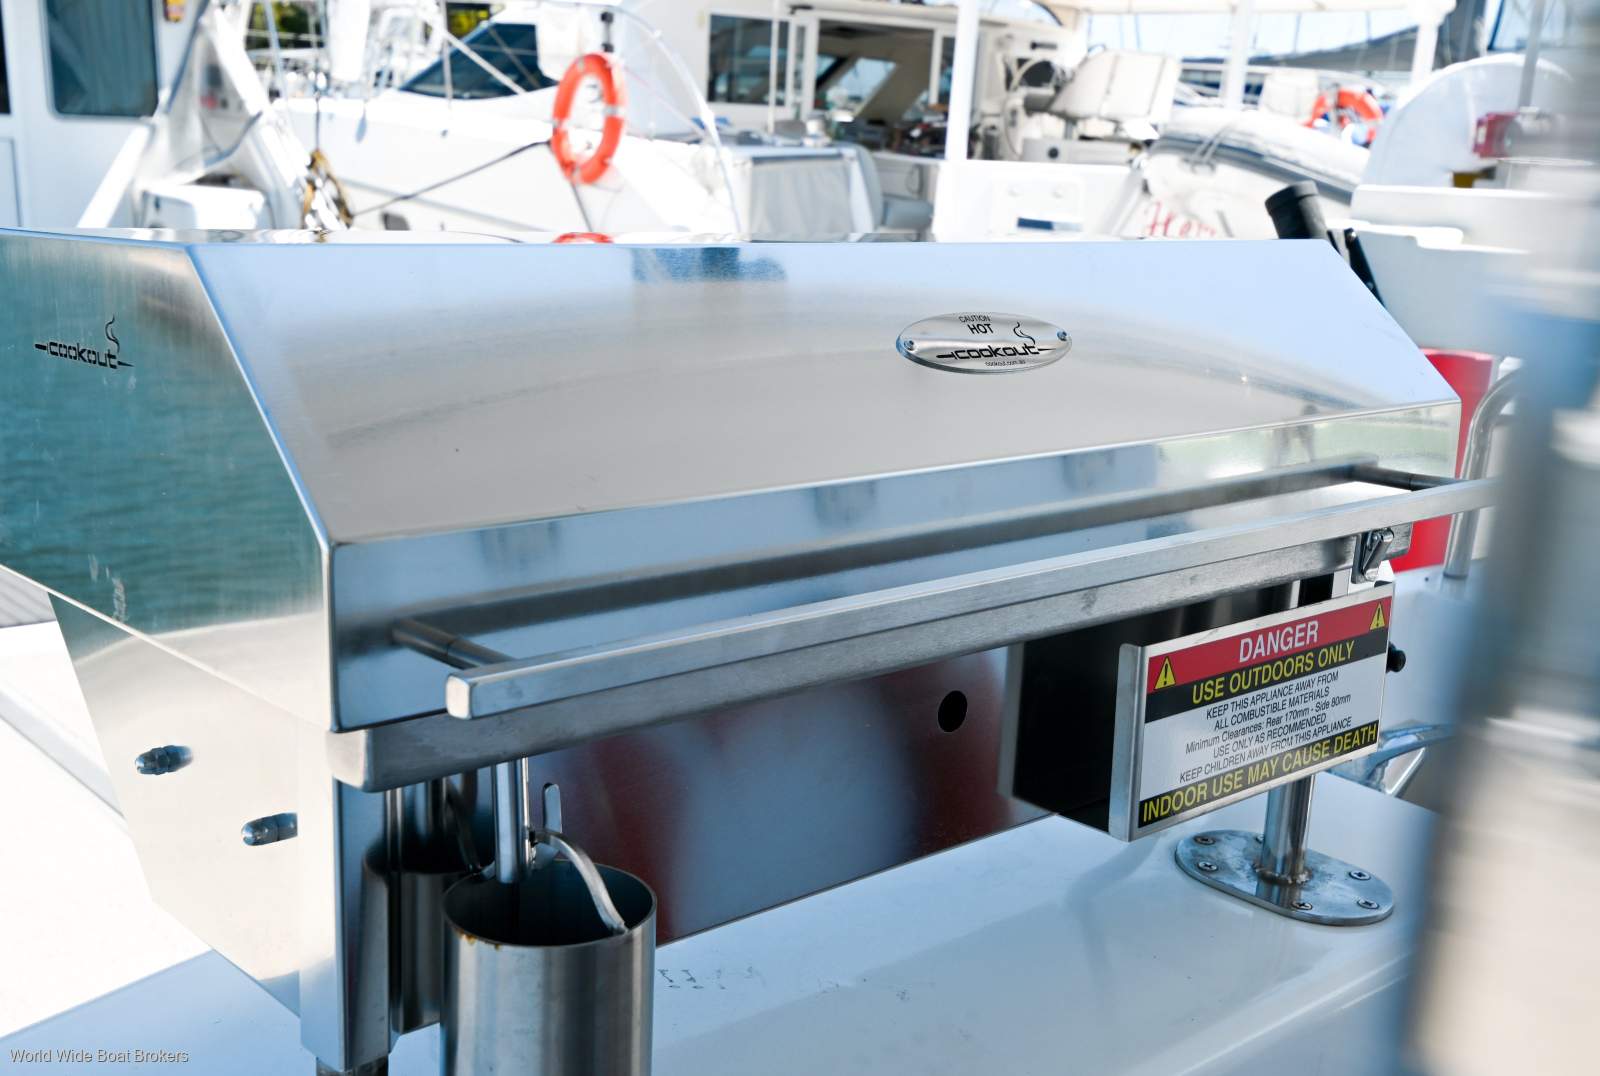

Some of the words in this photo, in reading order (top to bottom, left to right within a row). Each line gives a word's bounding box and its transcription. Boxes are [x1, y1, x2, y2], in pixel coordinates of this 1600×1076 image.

[959, 314, 991, 323] CAUTION
[967, 324, 994, 334] HOT
[48, 341, 118, 369] cookout
[953, 343, 1040, 360] cookout
[1239, 620, 1319, 663] DANGER
[1192, 677, 1225, 705] USE
[1229, 652, 1314, 694] OUTDOORS
[1318, 640, 1355, 668] ONLY
[1206, 703, 1229, 720] KEEP
[1230, 697, 1249, 713] THIS
[1250, 684, 1294, 707] APPLIANCE
[1294, 678, 1316, 693] AWAY
[1316, 670, 1339, 684] FROM
[1185, 734, 1220, 754] Minimum
[1222, 721, 1265, 742] Clearances:
[1266, 715, 1283, 728] Rear
[1285, 707, 1310, 721] 170mm
[1315, 697, 1330, 713] Side
[1331, 694, 1352, 708] 80mm
[1214, 718, 1229, 731] ALL
[1230, 699, 1287, 726] COMBUSTIBLE
[1288, 686, 1330, 709] MATERIALS
[1179, 767, 1203, 783] KEEP
[1204, 754, 1246, 775] CHILDREN
[1247, 744, 1269, 760] AWAY
[1270, 736, 1294, 753] FROM
[1294, 729, 1312, 744] THIS
[1312, 716, 1352, 738] APPLIANCE
[1213, 743, 1230, 759] USE
[1232, 736, 1254, 753] ONLY
[1254, 732, 1266, 746] AS
[1267, 713, 1327, 741] RECOMMENDED
[1142, 782, 1208, 822] INDOOR
[1212, 768, 1244, 797] USE
[1247, 757, 1280, 785] MAY
[1282, 742, 1331, 772] CAUSE
[1333, 723, 1377, 757] DEATH
